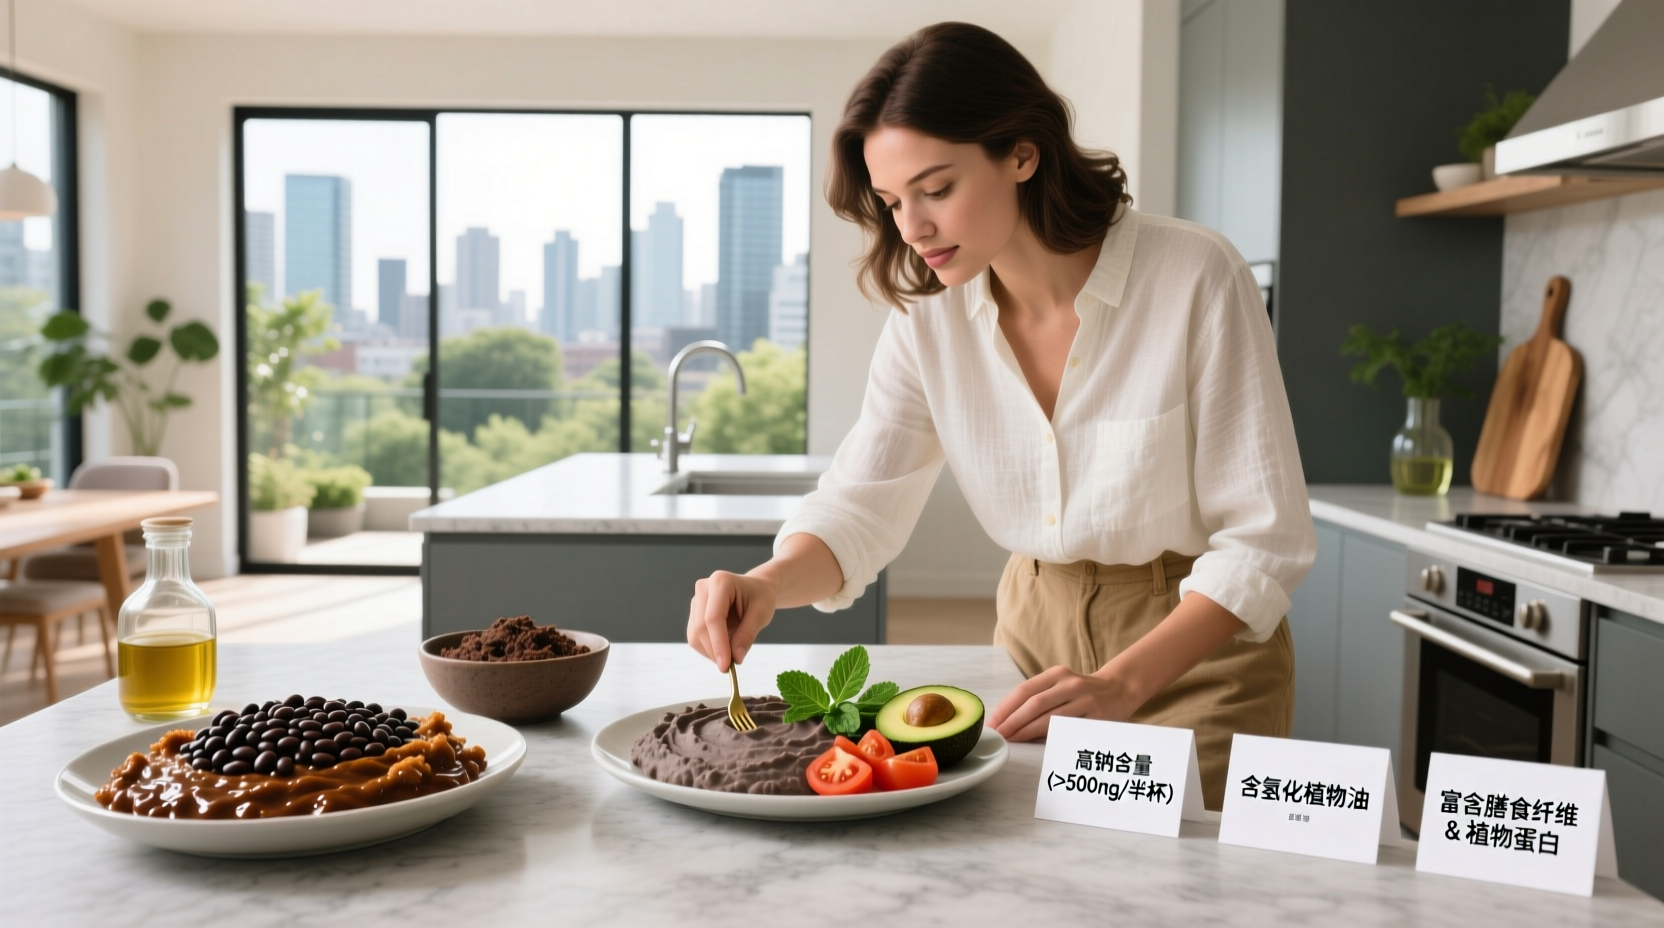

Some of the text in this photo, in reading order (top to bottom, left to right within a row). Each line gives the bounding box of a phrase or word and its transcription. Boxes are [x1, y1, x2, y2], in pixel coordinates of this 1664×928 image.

[1076, 749, 1153, 777] 高钠含量
[1047, 770, 1174, 805] (>500ng/半杯)
[1241, 774, 1370, 811] 含氢化植物油
[1440, 789, 1579, 827] 富含膳食纤维
[1445, 820, 1559, 856] & 植物蛋白
